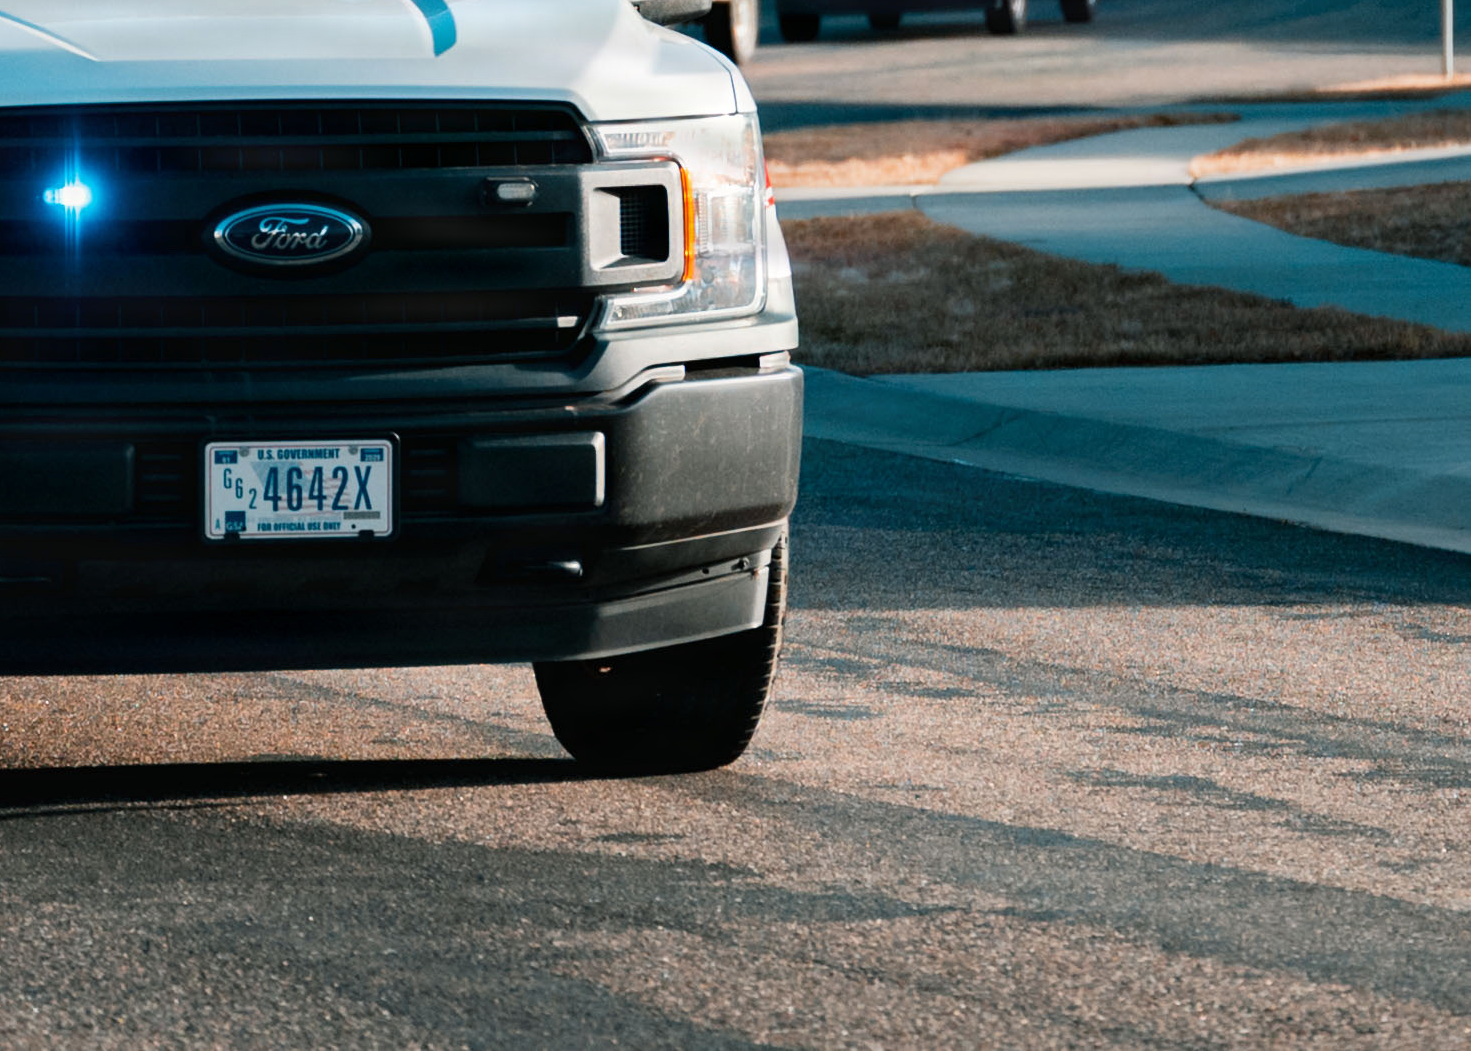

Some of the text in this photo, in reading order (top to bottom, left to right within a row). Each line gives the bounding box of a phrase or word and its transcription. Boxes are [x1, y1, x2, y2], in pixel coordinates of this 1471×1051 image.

[251, 216, 328, 250] Ford
[257, 448, 340, 460] U.S. GOVERNMENT
[263, 465, 372, 512] 4642X
[257, 521, 341, 531] FOR OFFICIAL USE ONLY
